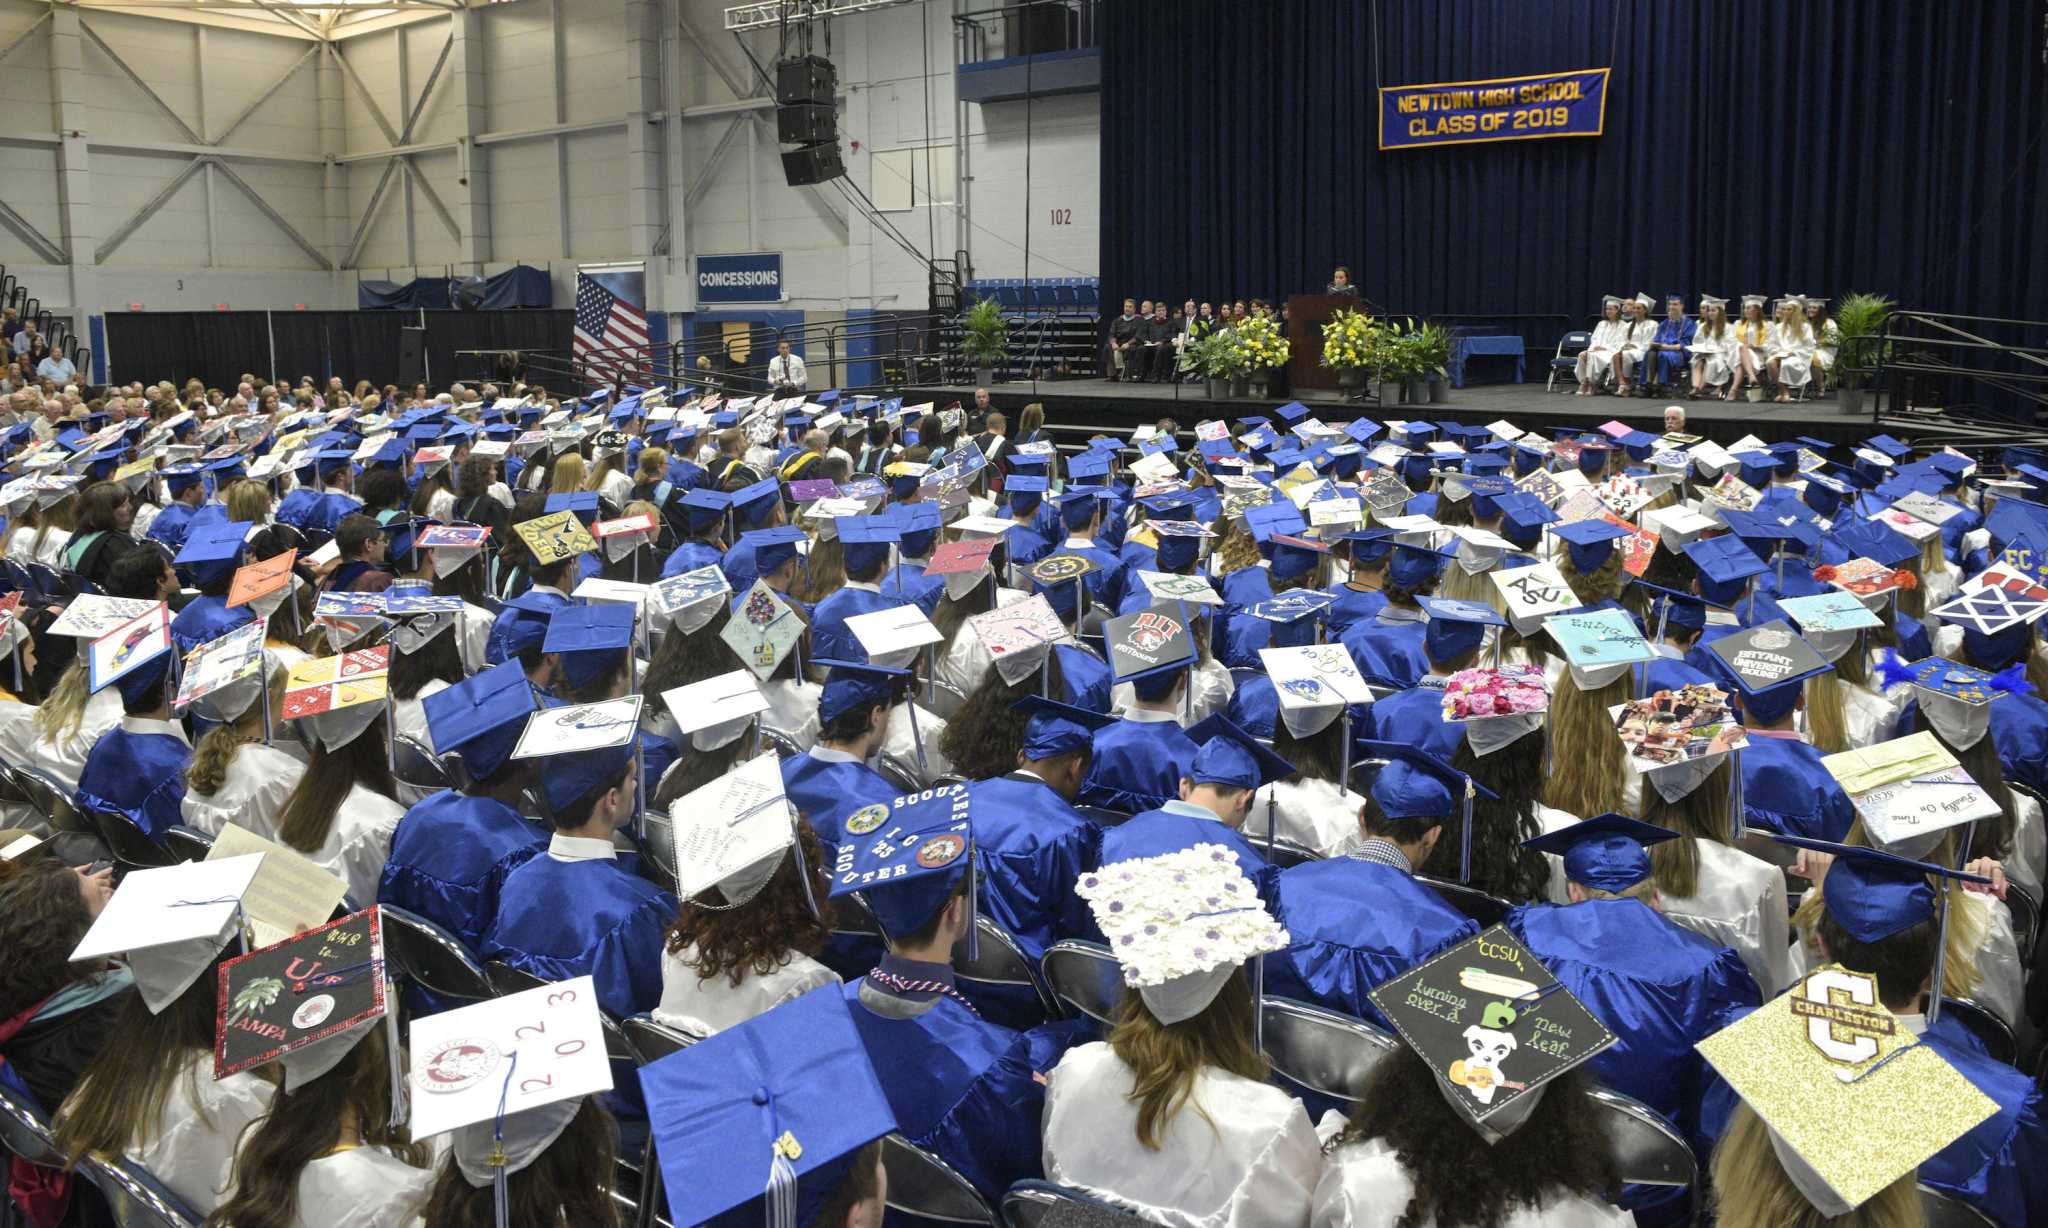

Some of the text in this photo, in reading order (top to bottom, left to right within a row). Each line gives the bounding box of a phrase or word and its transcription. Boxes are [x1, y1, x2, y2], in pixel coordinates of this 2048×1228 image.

[1398, 80, 1585, 113] NEWTOWN HIGH SCHOOL
[1408, 106, 1569, 137] CLASS OF 2019
[1050, 208, 1072, 226] 102
[700, 270, 778, 288] CONCESSIONS
[1507, 576, 1561, 605] ASU
[1129, 611, 1184, 642] RIT
[1114, 643, 1159, 664] #RITbound
[1738, 650, 1793, 667] BRYANT
[1733, 657, 1793, 675] UNIVERSITY
[1740, 667, 1779, 680] BOUND
[1891, 814, 1921, 826] Time
[1920, 805, 1937, 814] On
[1479, 941, 1520, 963] CCSU
[1412, 977, 1468, 1010] turning
[1407, 993, 1460, 1022] over a
[1795, 1001, 1889, 1032] CHARLESTON
[1535, 1017, 1573, 1039] new
[1528, 1031, 1570, 1055] leaf
